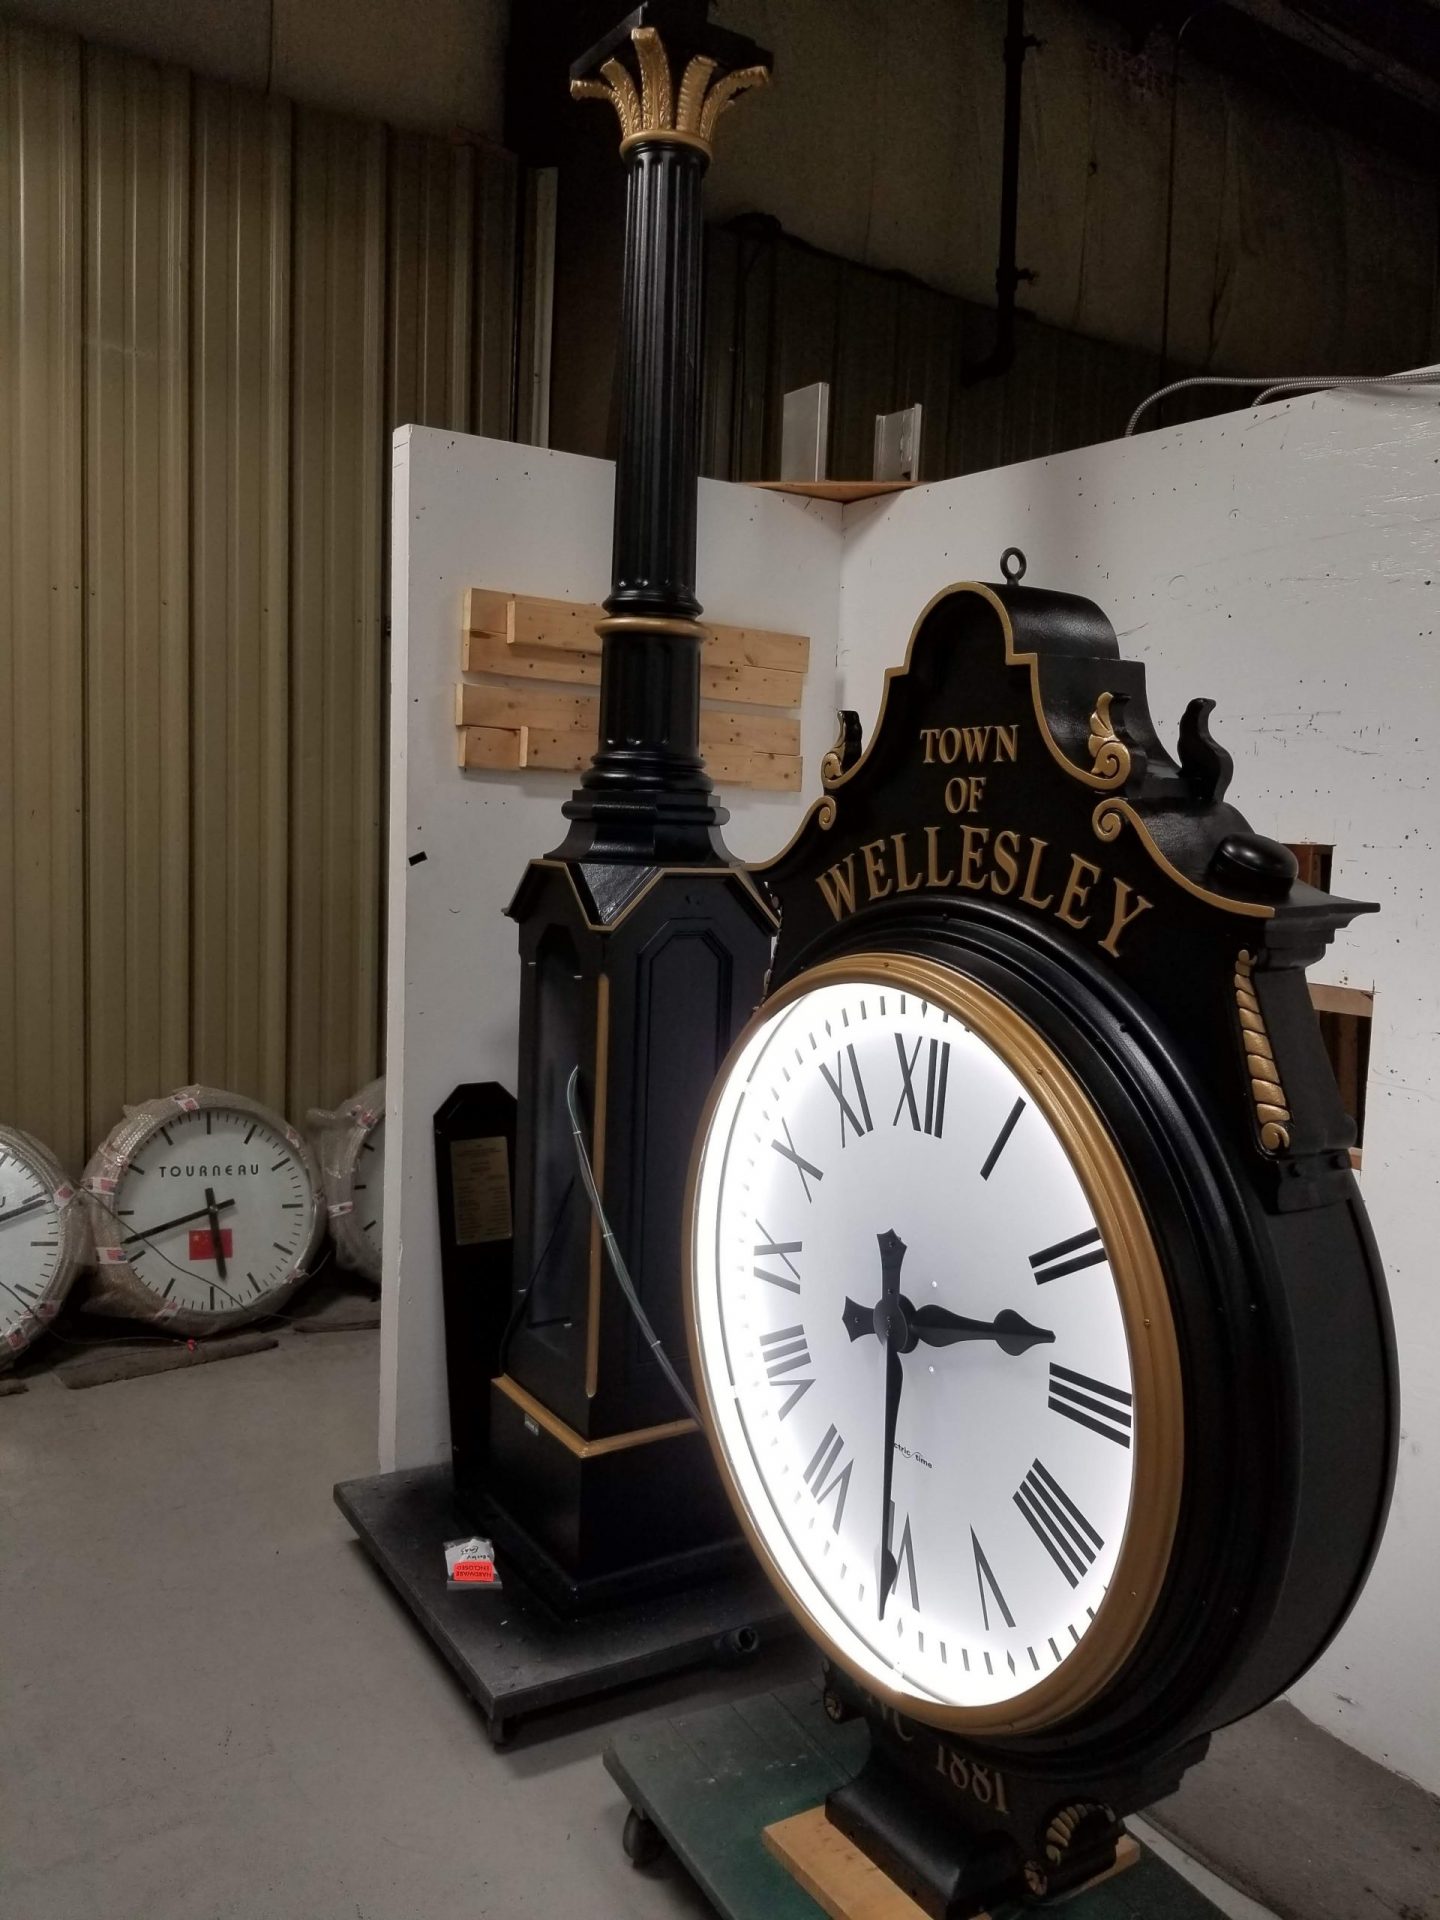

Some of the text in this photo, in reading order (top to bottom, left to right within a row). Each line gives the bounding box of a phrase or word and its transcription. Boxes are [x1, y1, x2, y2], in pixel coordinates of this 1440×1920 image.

[920, 724, 1020, 764] TOWN
[945, 776, 986, 814] OF
[815, 824, 1154, 958] WELLESLEY
[819, 1043, 874, 1148] XI
[893, 1032, 950, 1139] XII
[159, 1164, 259, 1178] TOURNEAU
[771, 1117, 824, 1204] X
[979, 1096, 1026, 1181] I
[759, 1324, 816, 1422] VIII
[1047, 1362, 1133, 1449] III
[802, 1423, 854, 1535] VII
[894, 1442, 933, 1469] ctric time
[1012, 1457, 1105, 1589] IIII
[969, 1524, 1016, 1632] V
[936, 1744, 1011, 1815] 1881
